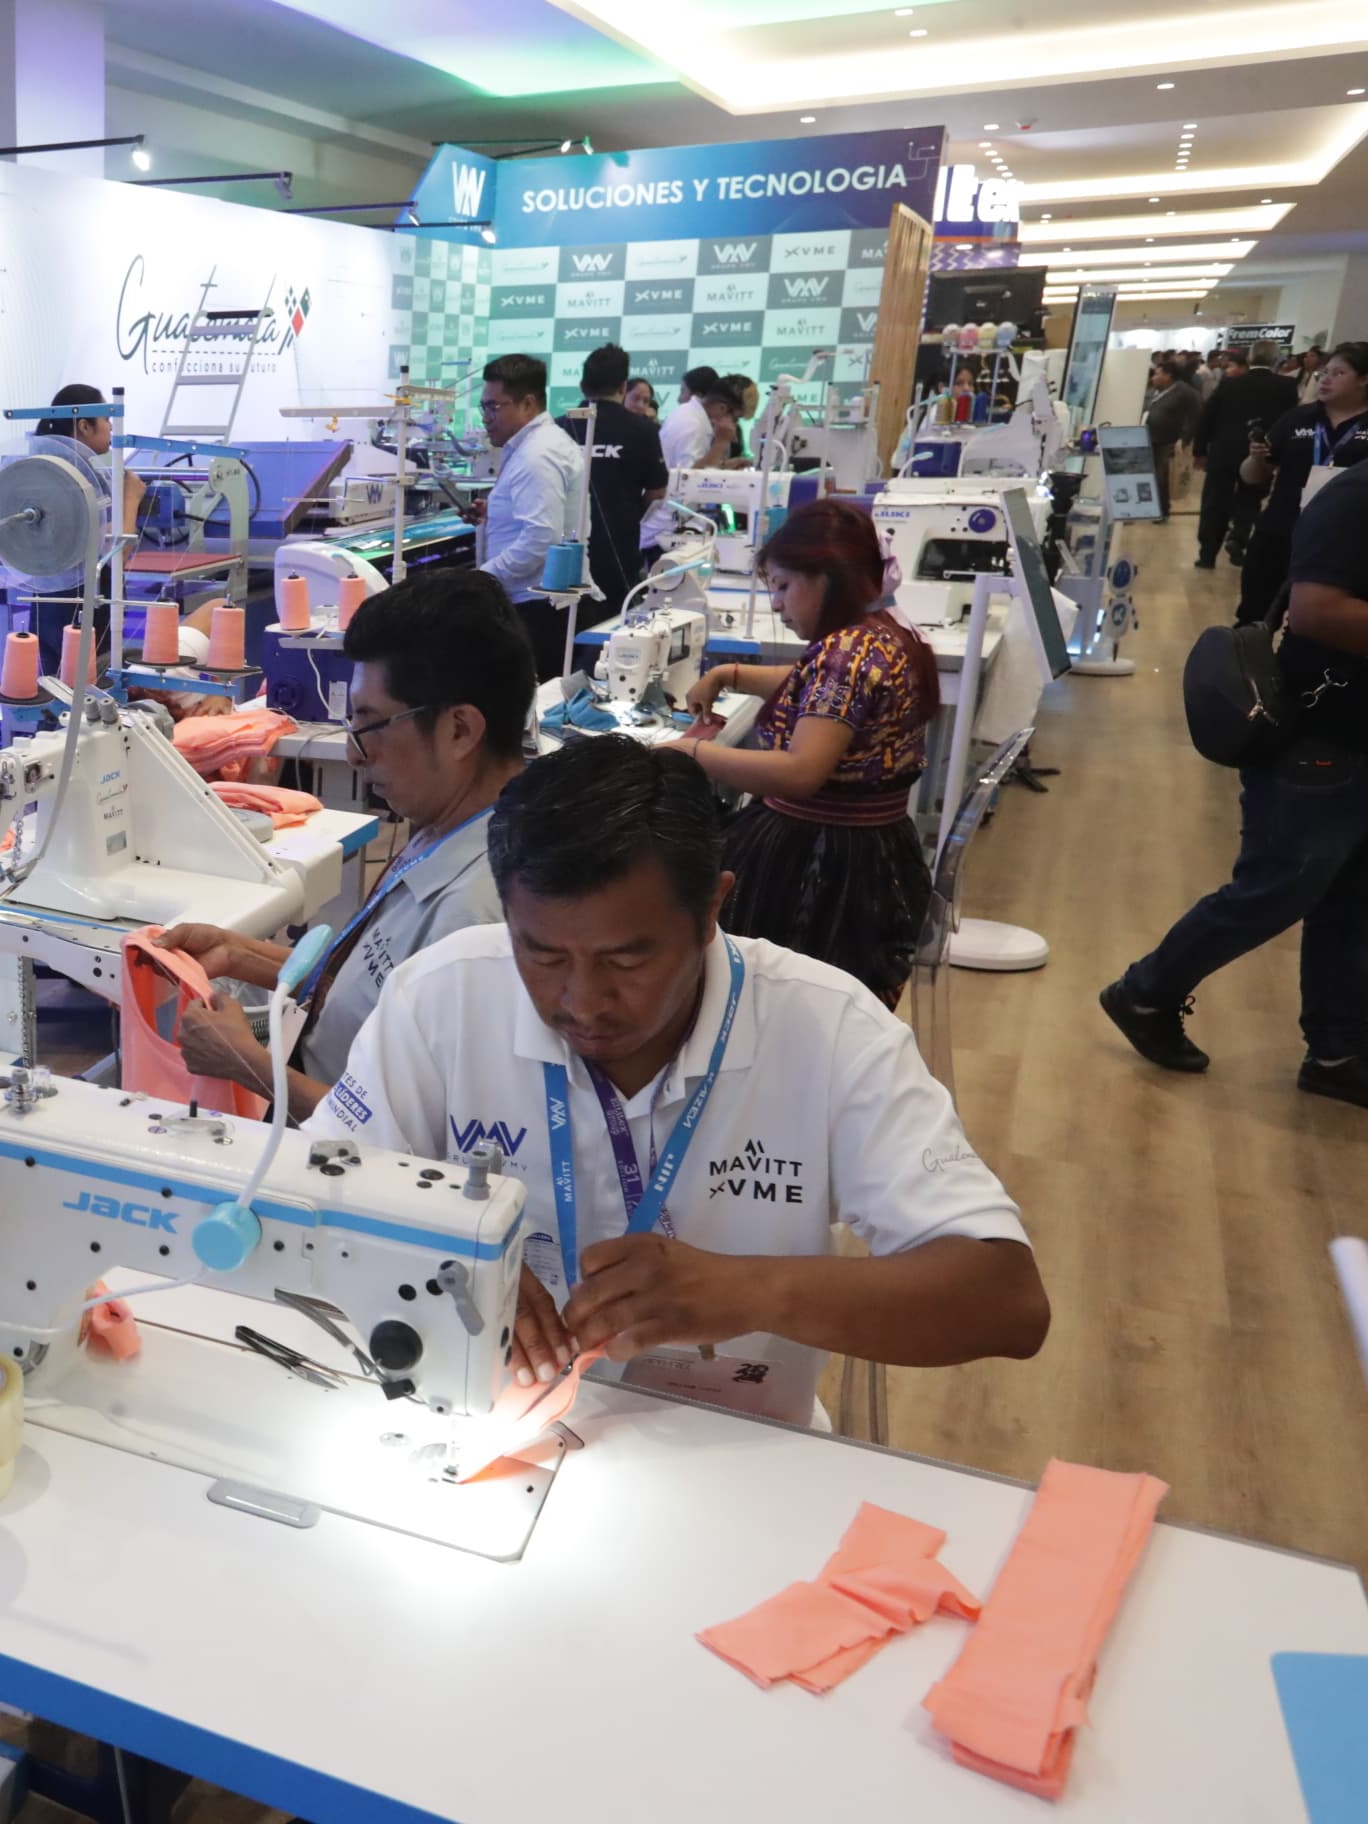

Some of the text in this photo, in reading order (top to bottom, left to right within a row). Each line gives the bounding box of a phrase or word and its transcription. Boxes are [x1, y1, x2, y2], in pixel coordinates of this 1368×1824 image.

[522, 163, 907, 214] SOLUCIONES Y TECNOLOGIA
[568, 298, 611, 308] MAVITT
[707, 291, 754, 302] MAVITT
[777, 325, 825, 336] MAVITT
[152, 359, 277, 373] confcciona su uturo
[588, 444, 623, 459] CK
[336, 1084, 368, 1122] LÍDERES
[355, 1085, 368, 1099] DE
[331, 1102, 358, 1132] NDIAL
[623, 1162, 641, 1184] 31
[709, 1155, 803, 1177] MAVITT
[562, 1160, 573, 1202] MAVITT
[62, 1191, 181, 1234] JACK
